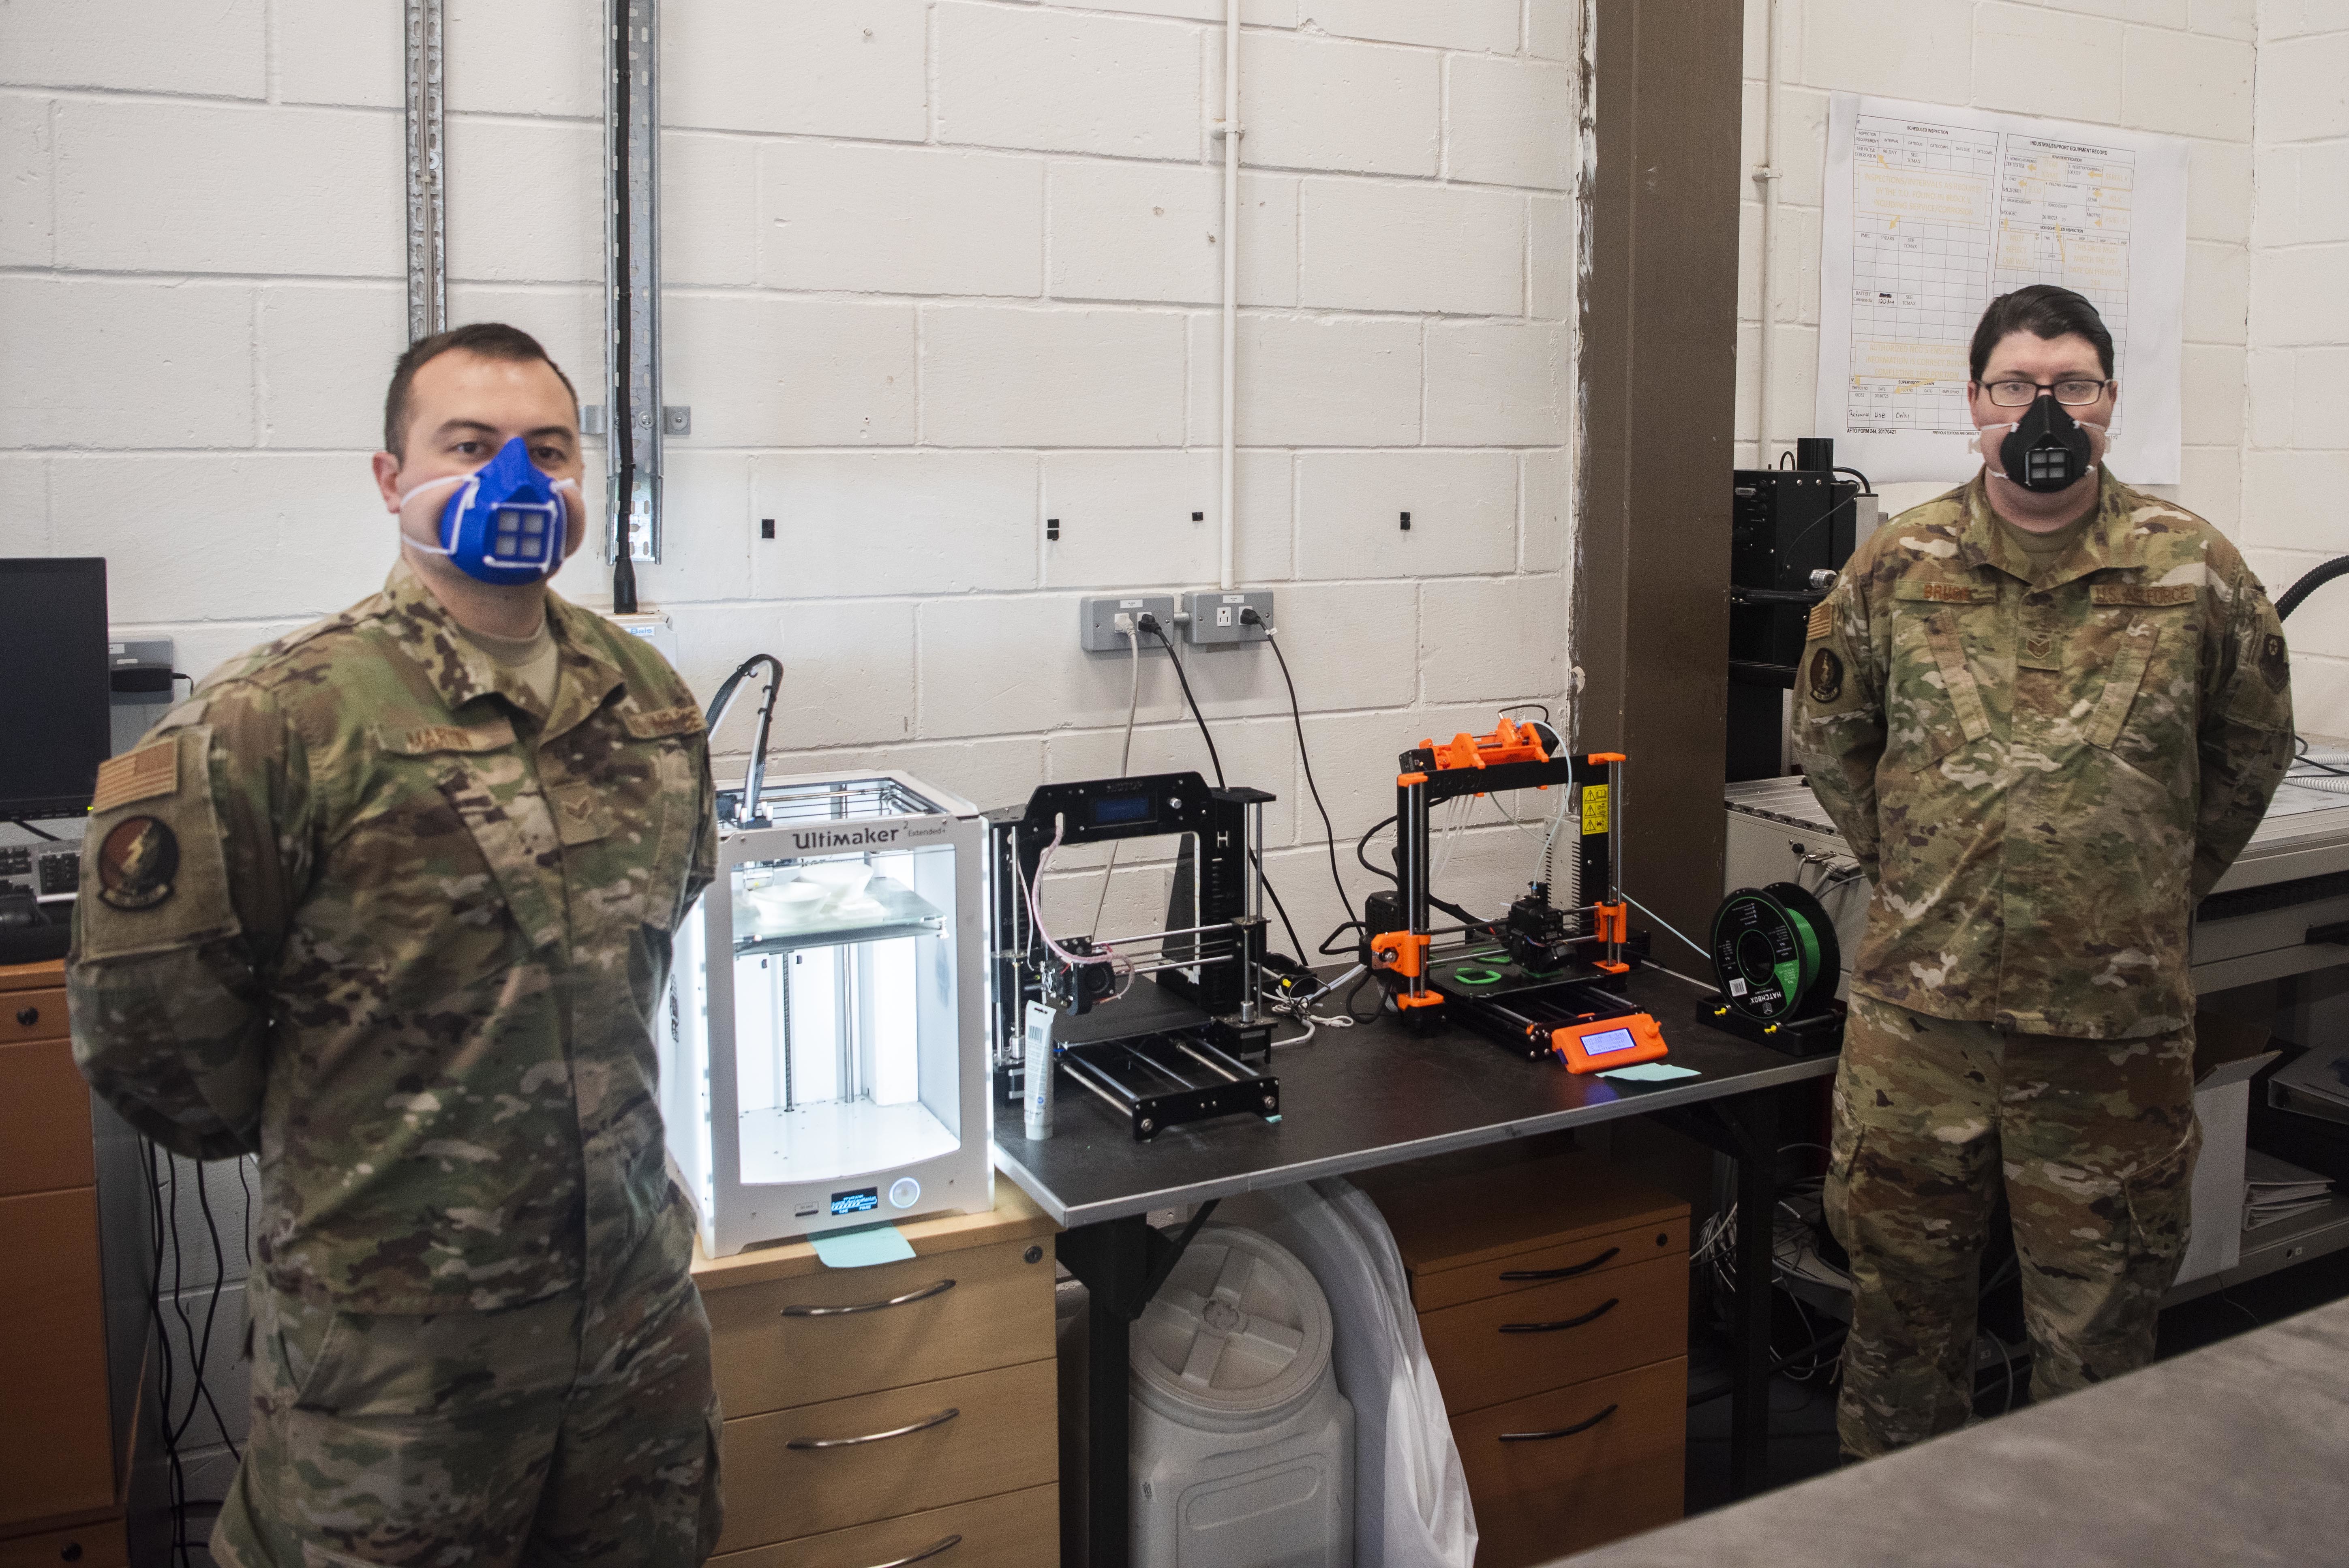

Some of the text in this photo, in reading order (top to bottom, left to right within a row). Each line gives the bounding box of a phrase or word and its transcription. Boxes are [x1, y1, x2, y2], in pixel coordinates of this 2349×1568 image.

[1954, 183, 1982, 193] REQUIRED
[1884, 188, 1896, 196] THE
[1912, 191, 1936, 200] FOUND
[1946, 194, 1966, 203] BLOCK
[1874, 199, 1973, 215] INCLUDING SERVICE/CORROSION
[1870, 345, 1908, 353] AUTHORIZED
[1931, 347, 1955, 355] ENSURE
[1866, 356, 1908, 365] INFORMATION
[1917, 358, 1944, 366] CORRECT
[1875, 368, 1914, 377] COMPLETING
[2147, 586, 2190, 604] FORCE
[792, 828, 899, 848] Ultimaker
[1750, 991, 1782, 1003] HATCHBOX
